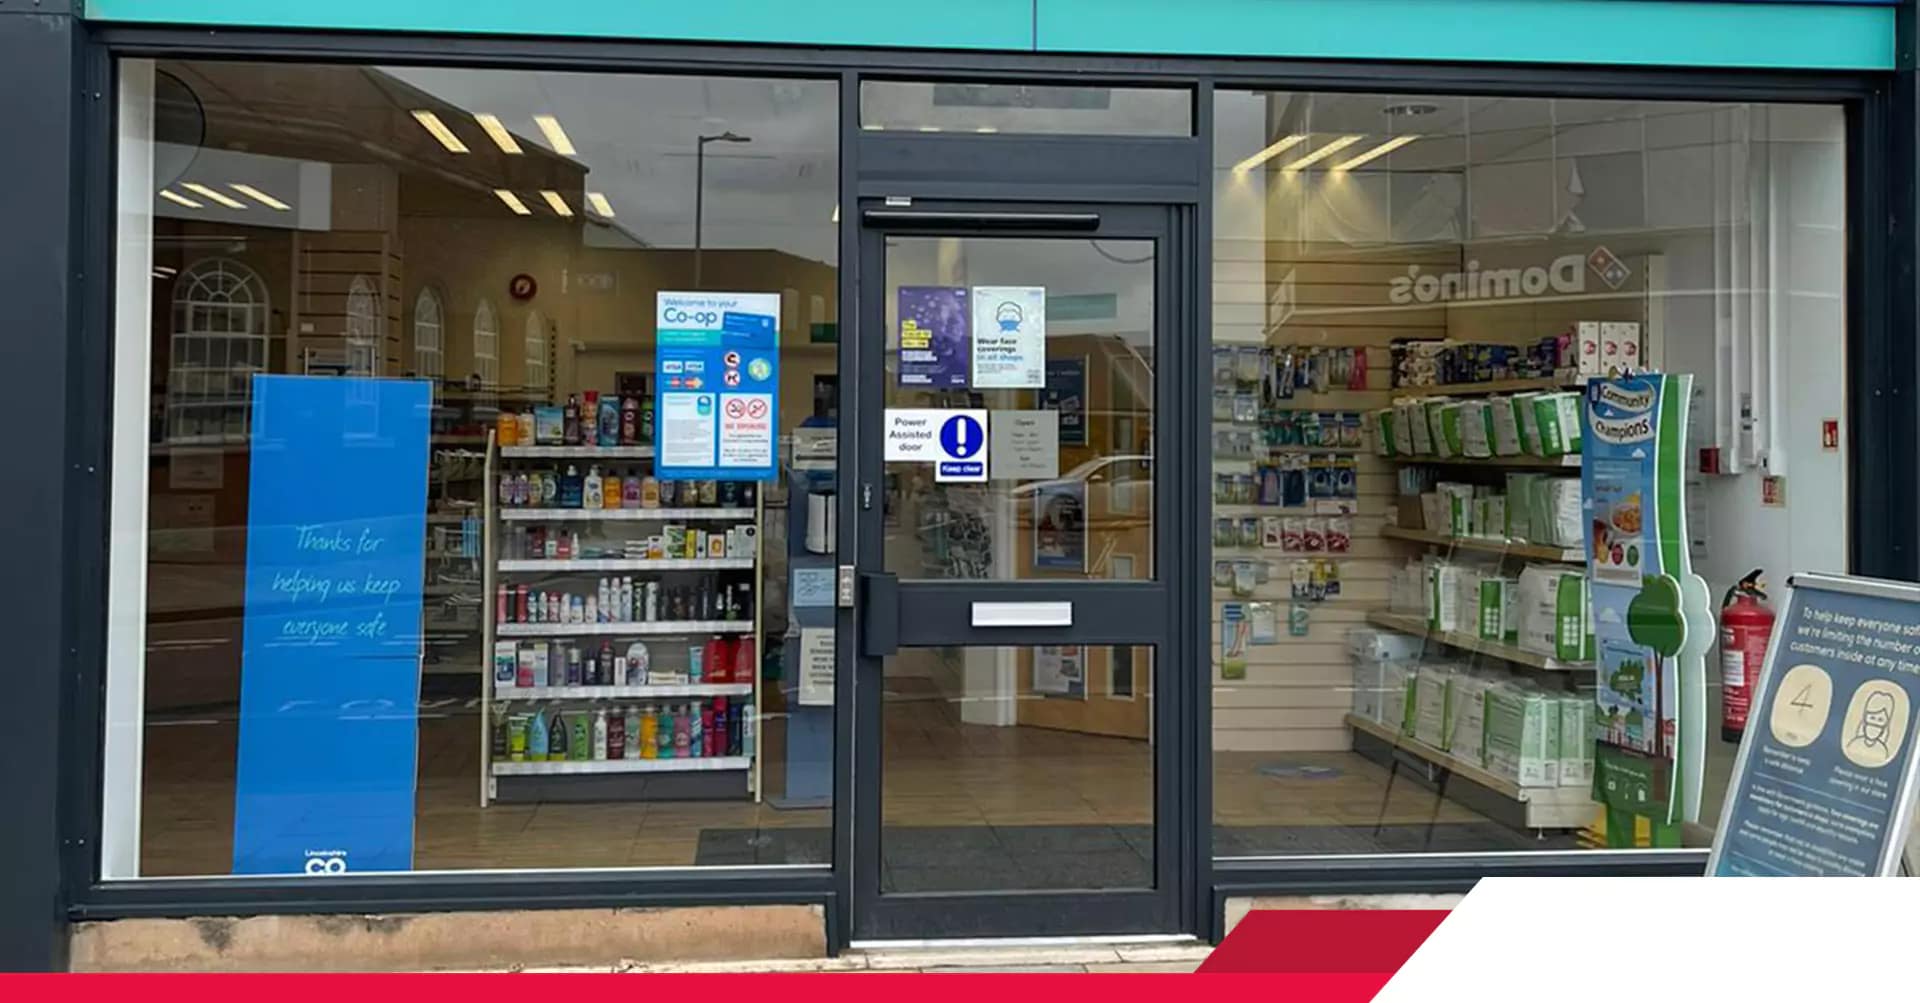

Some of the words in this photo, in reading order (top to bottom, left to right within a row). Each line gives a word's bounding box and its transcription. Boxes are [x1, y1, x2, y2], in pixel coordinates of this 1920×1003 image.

[663, 298, 705, 307] Welcome
[707, 299, 717, 307] to
[718, 300, 738, 309] your
[664, 307, 717, 327] Co-op
[977, 346, 1016, 355] coverings
[1000, 337, 1017, 345] face
[999, 354, 1023, 362] shops
[1602, 385, 1649, 409] Community
[894, 417, 927, 427] Power
[889, 430, 932, 440] Assisted
[898, 442, 922, 451] door
[942, 464, 961, 474] Keep
[962, 463, 981, 473] clear
[295, 525, 352, 553] Thanks
[356, 526, 384, 553] for
[272, 569, 330, 603] helping
[335, 579, 356, 594] us
[364, 572, 401, 601] keep
[283, 619, 348, 646] everyone
[356, 612, 386, 638] safe
[1803, 606, 1813, 619] To
[1813, 609, 1833, 624] help
[1834, 612, 1856, 628] keep
[1856, 617, 1902, 633] everyone
[1903, 624, 1920, 636] saf
[1797, 626, 1821, 638] we're
[1821, 626, 1855, 648] limiting
[1855, 634, 1872, 647] the
[1872, 639, 1912, 653] number
[1913, 646, 1920, 655] o
[1789, 640, 1835, 658] customers
[1837, 649, 1863, 663] inside
[1863, 655, 1876, 666] at
[1876, 657, 1898, 673] any
[1790, 682, 1814, 714] 4
